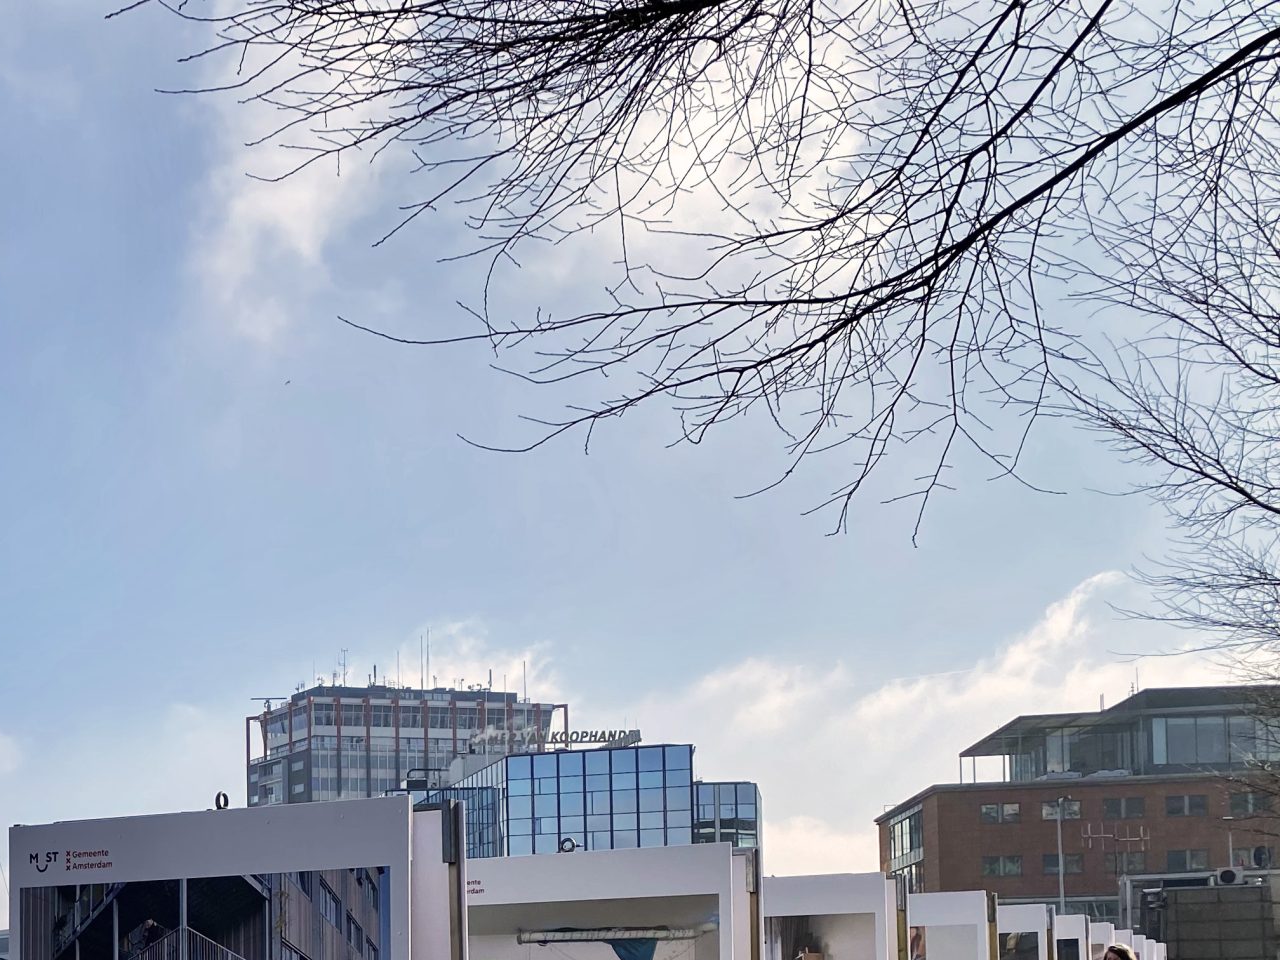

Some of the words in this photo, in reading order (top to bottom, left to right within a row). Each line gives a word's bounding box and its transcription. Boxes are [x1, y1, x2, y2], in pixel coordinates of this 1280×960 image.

[550, 729, 637, 744] KOOPHAND
[72, 849, 109, 858] Gemeente
[72, 860, 113, 870] Amsterdam
